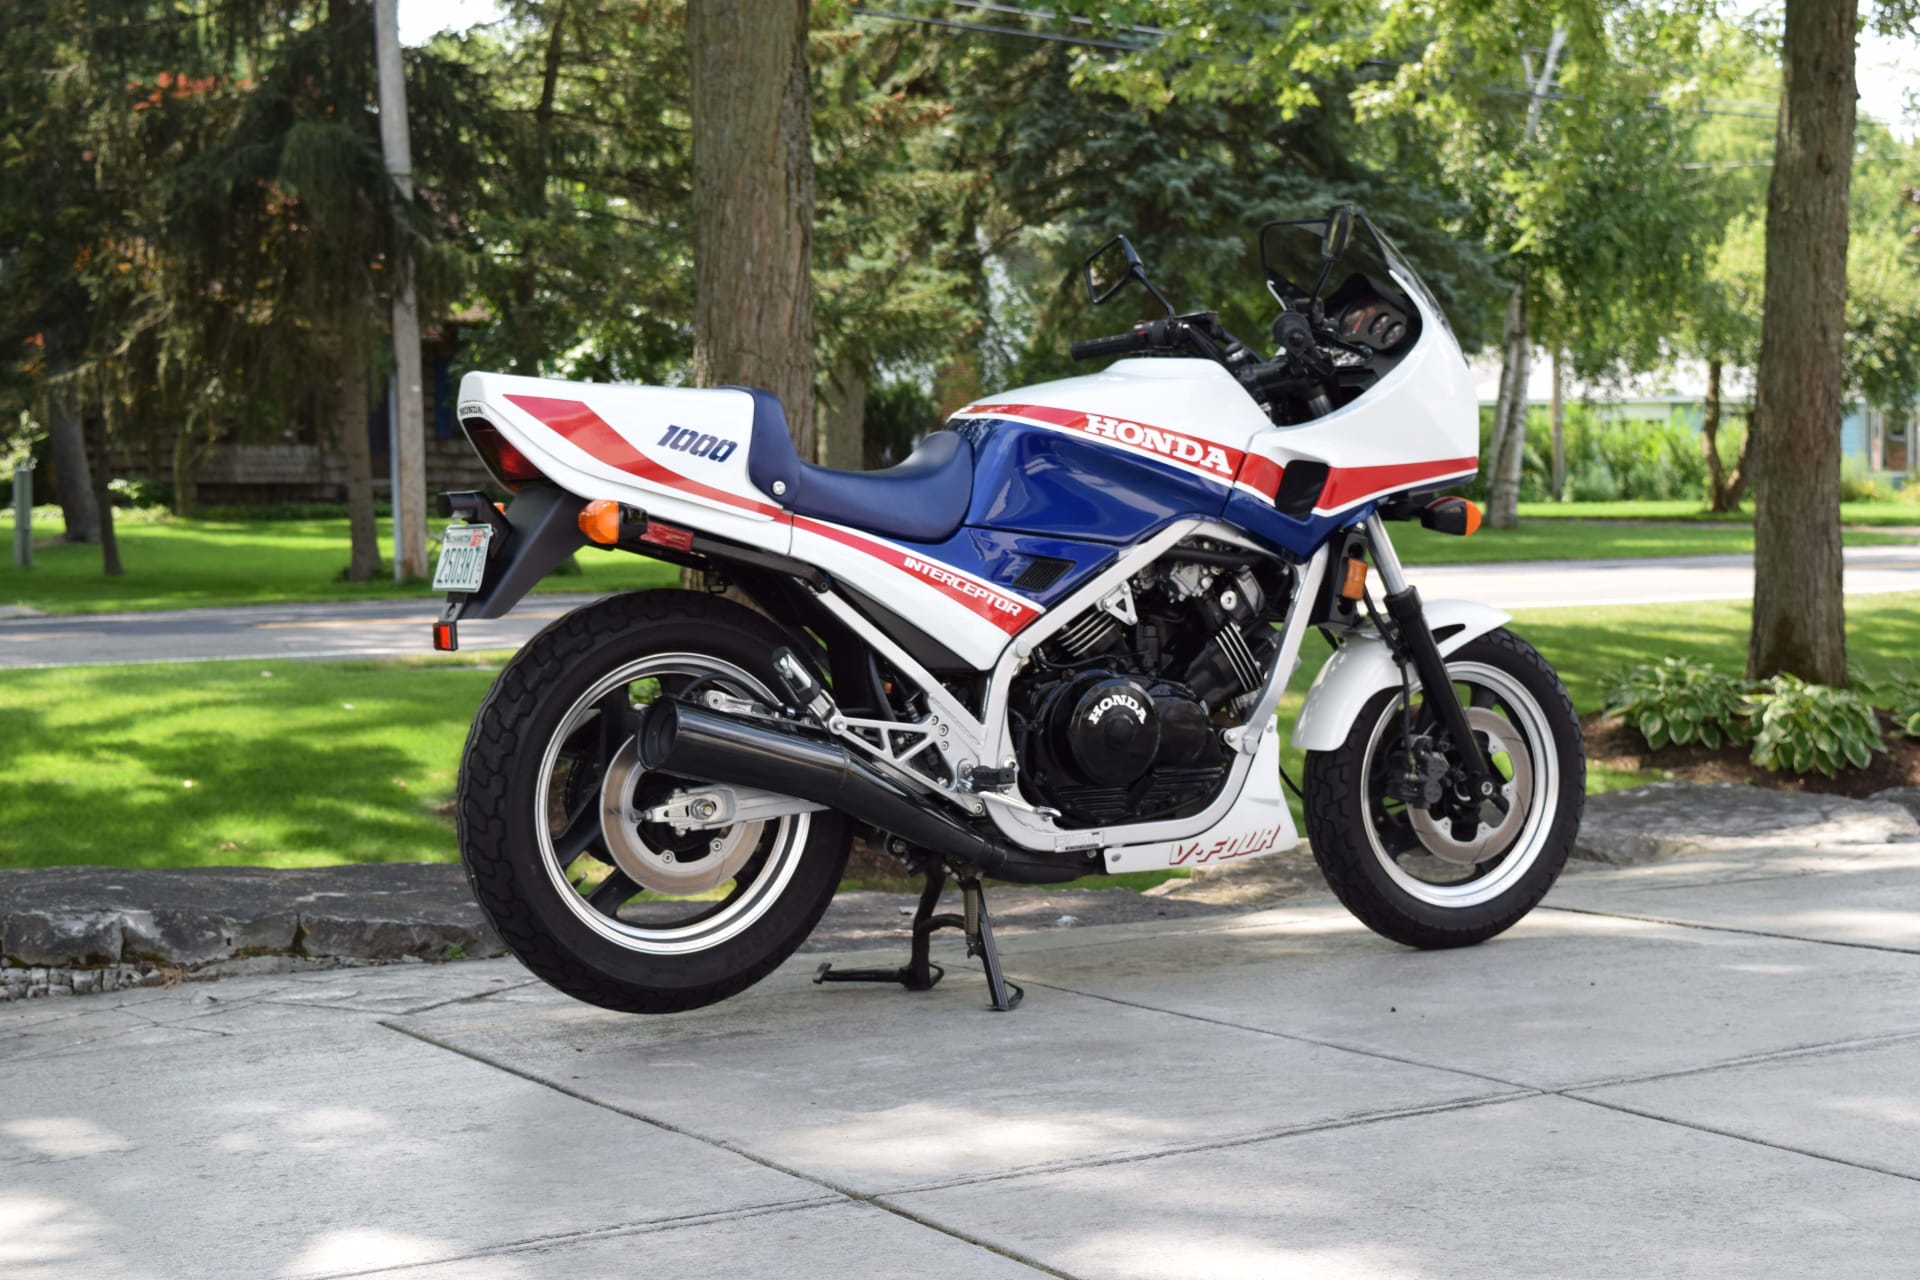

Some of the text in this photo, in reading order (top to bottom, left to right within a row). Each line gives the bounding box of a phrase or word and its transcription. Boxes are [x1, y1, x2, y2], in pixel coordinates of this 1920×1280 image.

[656, 424, 738, 463] 1000
[1085, 413, 1232, 475] HONDA
[903, 557, 1022, 617] INTERCEPTOR
[1088, 694, 1146, 725] HONDA
